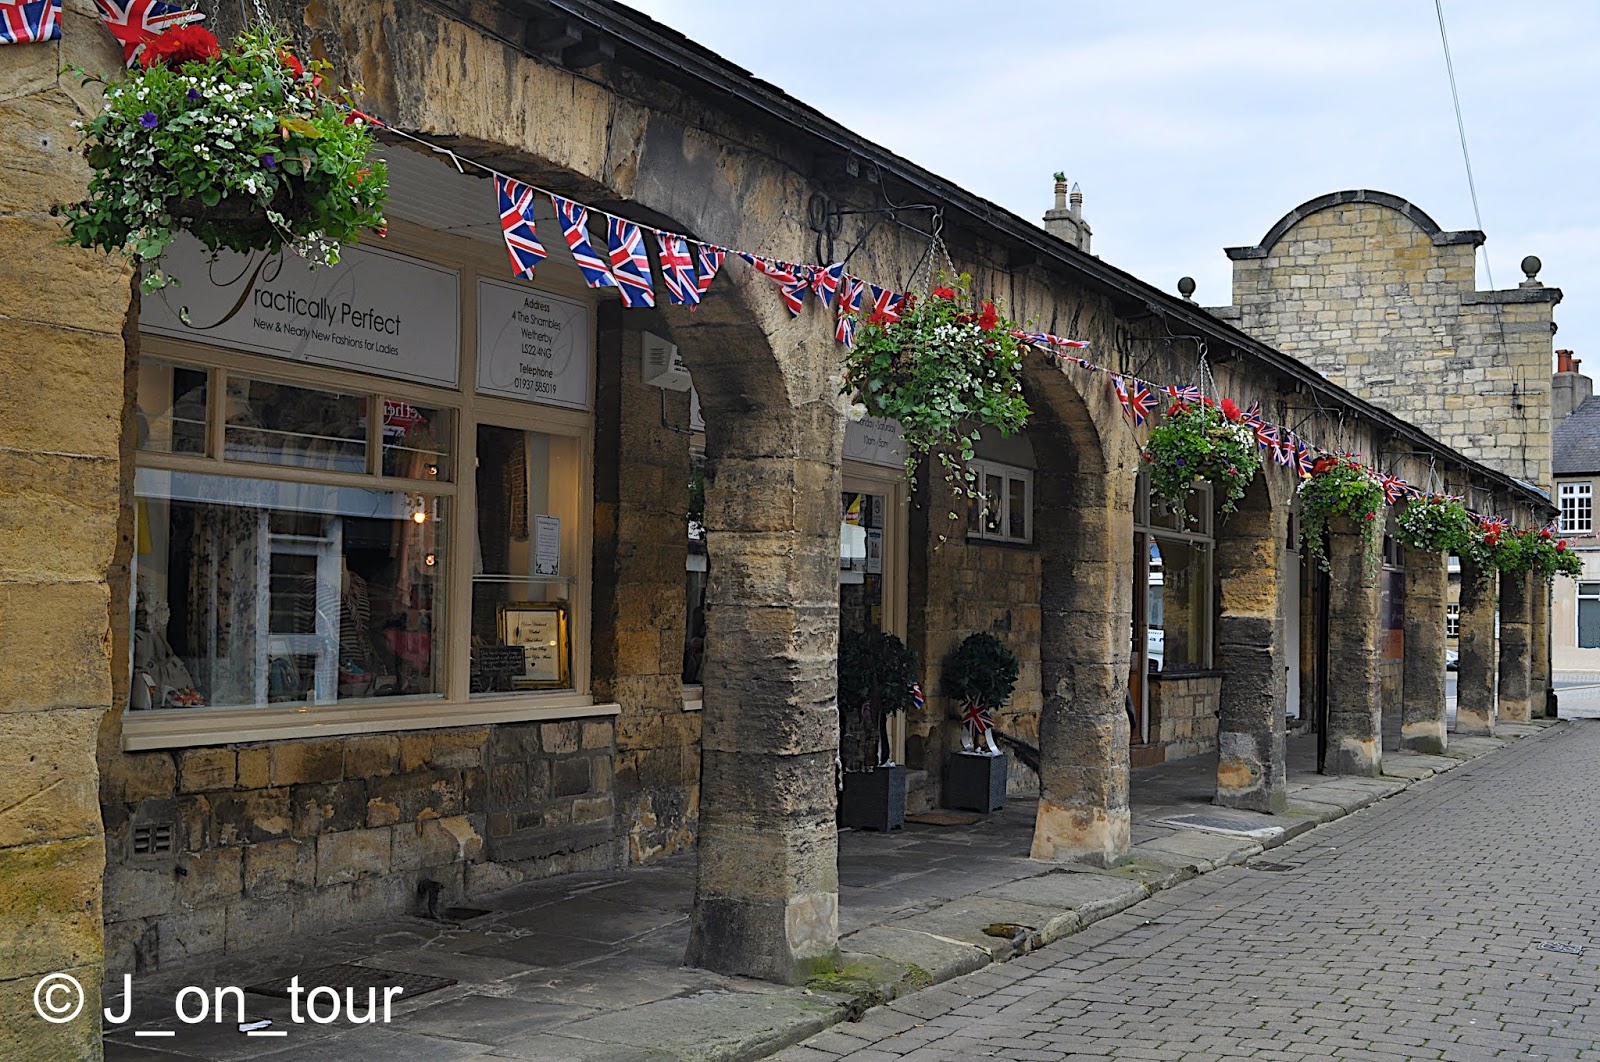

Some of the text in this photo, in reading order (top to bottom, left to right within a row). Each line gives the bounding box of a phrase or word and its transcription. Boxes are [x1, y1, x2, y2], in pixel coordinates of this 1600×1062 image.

[523, 298, 551, 313] Address
[341, 302, 401, 336] Perfect
[511, 311, 562, 331] 4 The Shambles
[253, 317, 399, 356] New & Nearly New Fashions for Ladies
[520, 328, 553, 346] Wetherby
[521, 344, 552, 359] LS22 4NG
[519, 363, 554, 379] Telephone
[514, 378, 534, 390] 01937
